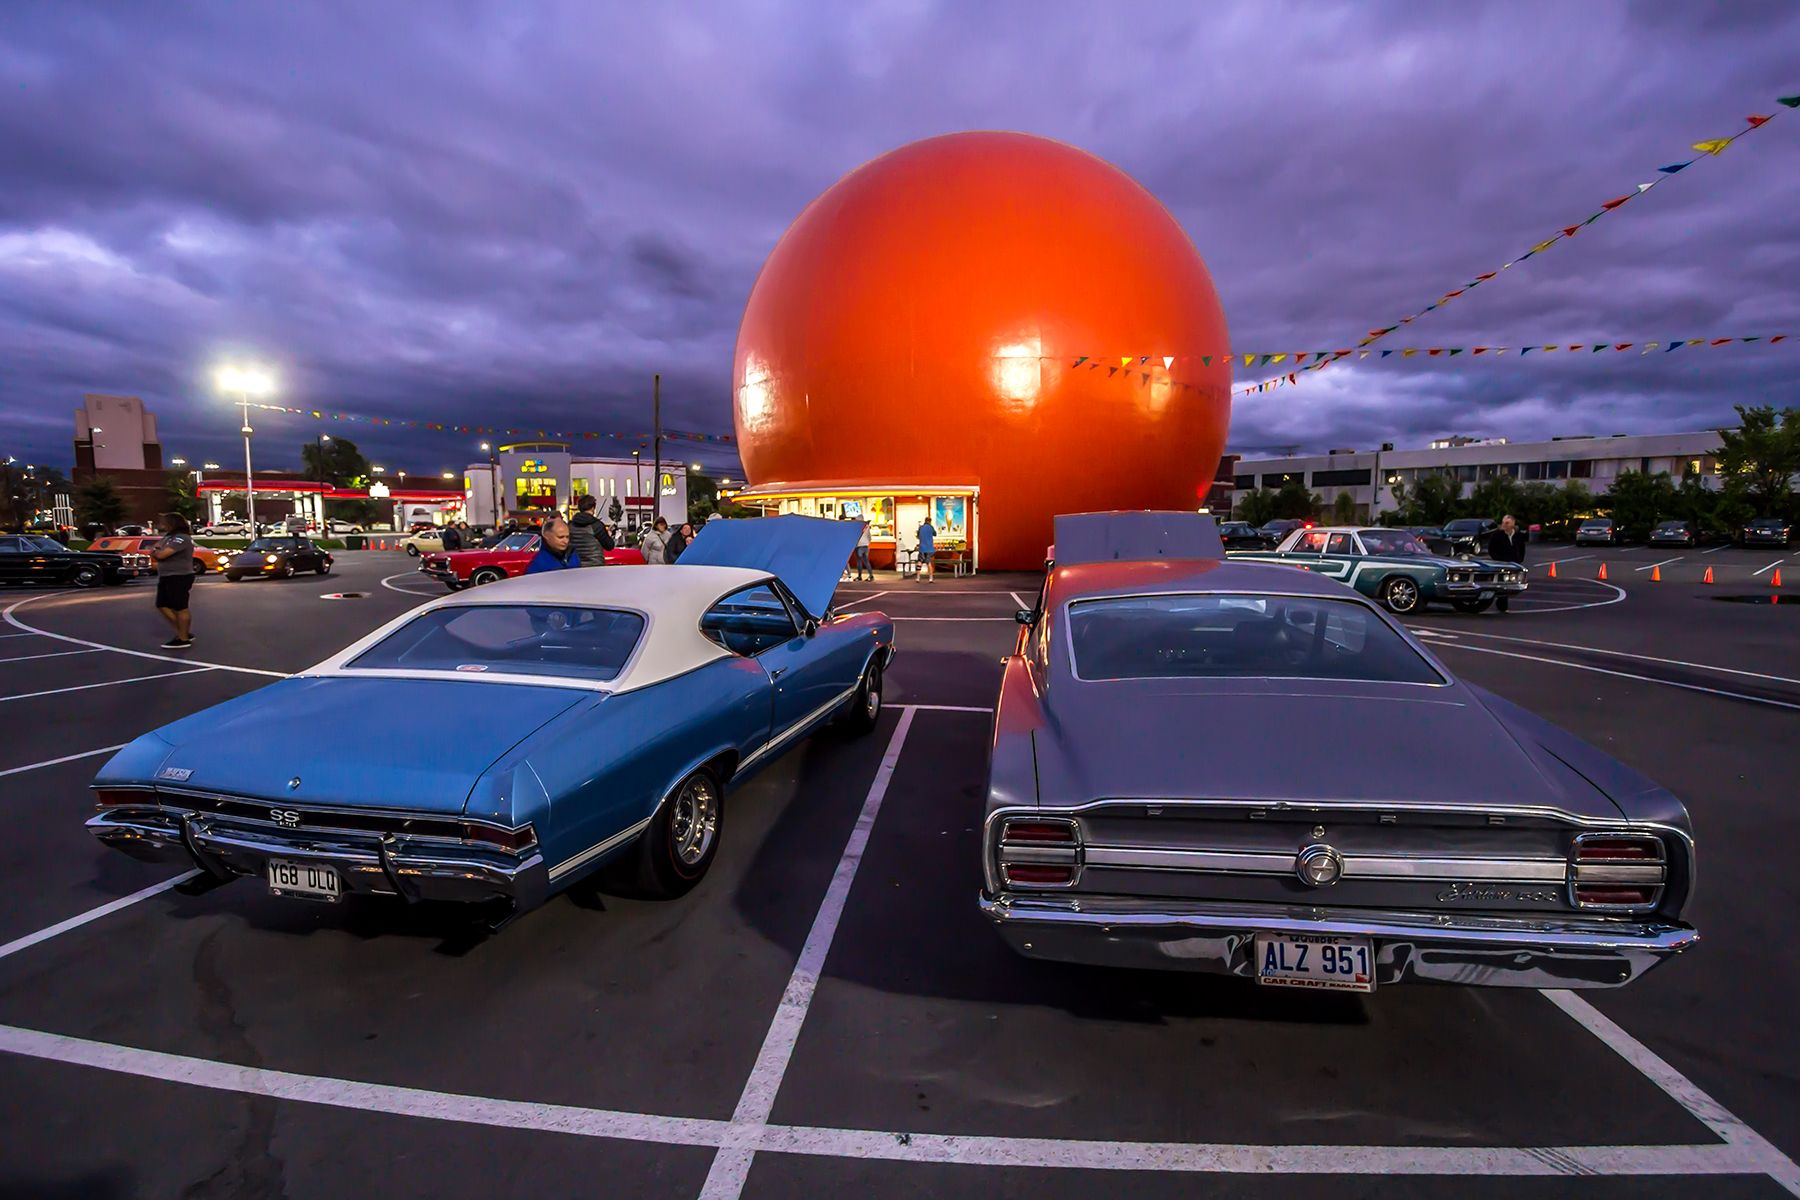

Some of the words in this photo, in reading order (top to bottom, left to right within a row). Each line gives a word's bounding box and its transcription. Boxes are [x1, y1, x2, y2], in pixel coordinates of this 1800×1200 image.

[270, 809, 300, 822] SS
[270, 862, 299, 886] Y68
[1264, 942, 1310, 973] ALZ
[1321, 945, 1368, 976] 951
[1263, 977, 1287, 985] CAR
[1290, 979, 1327, 987] CRAFT
